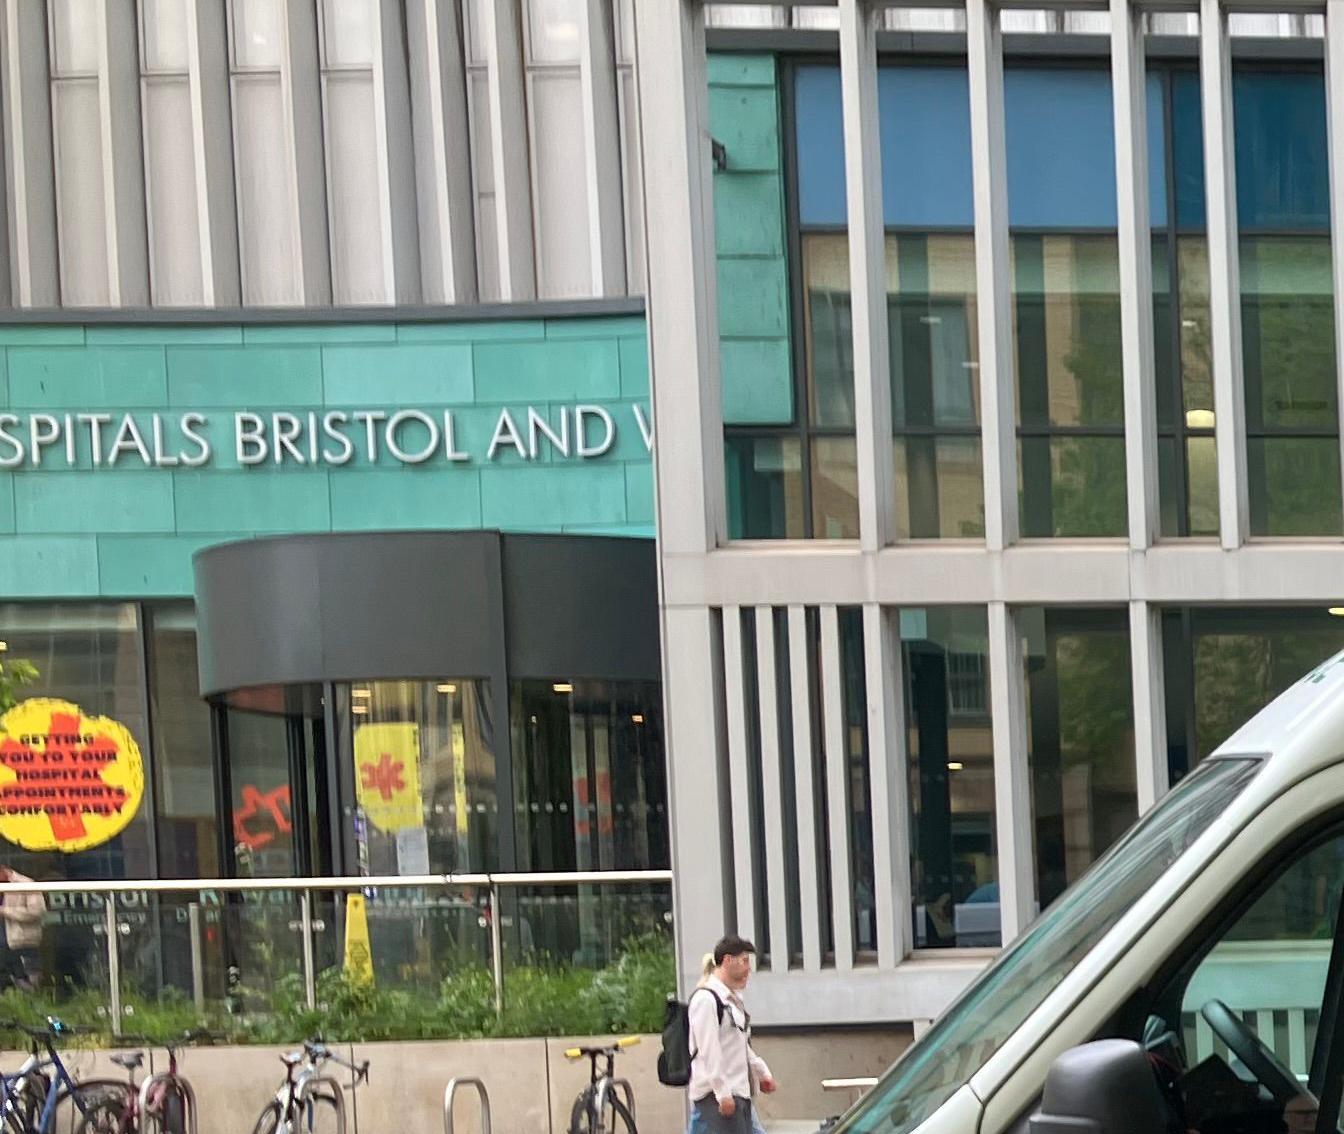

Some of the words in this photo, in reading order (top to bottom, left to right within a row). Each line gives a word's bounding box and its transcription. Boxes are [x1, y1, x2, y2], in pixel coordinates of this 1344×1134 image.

[234, 408, 470, 465] BRISTOL
[487, 404, 616, 459] AND
[20, 733, 94, 745] GETTING
[42, 751, 63, 763] TO
[71, 751, 118, 762] YOUR
[15, 769, 101, 780] HOSPITAL
[0, 786, 126, 798] PPOINTMENTS
